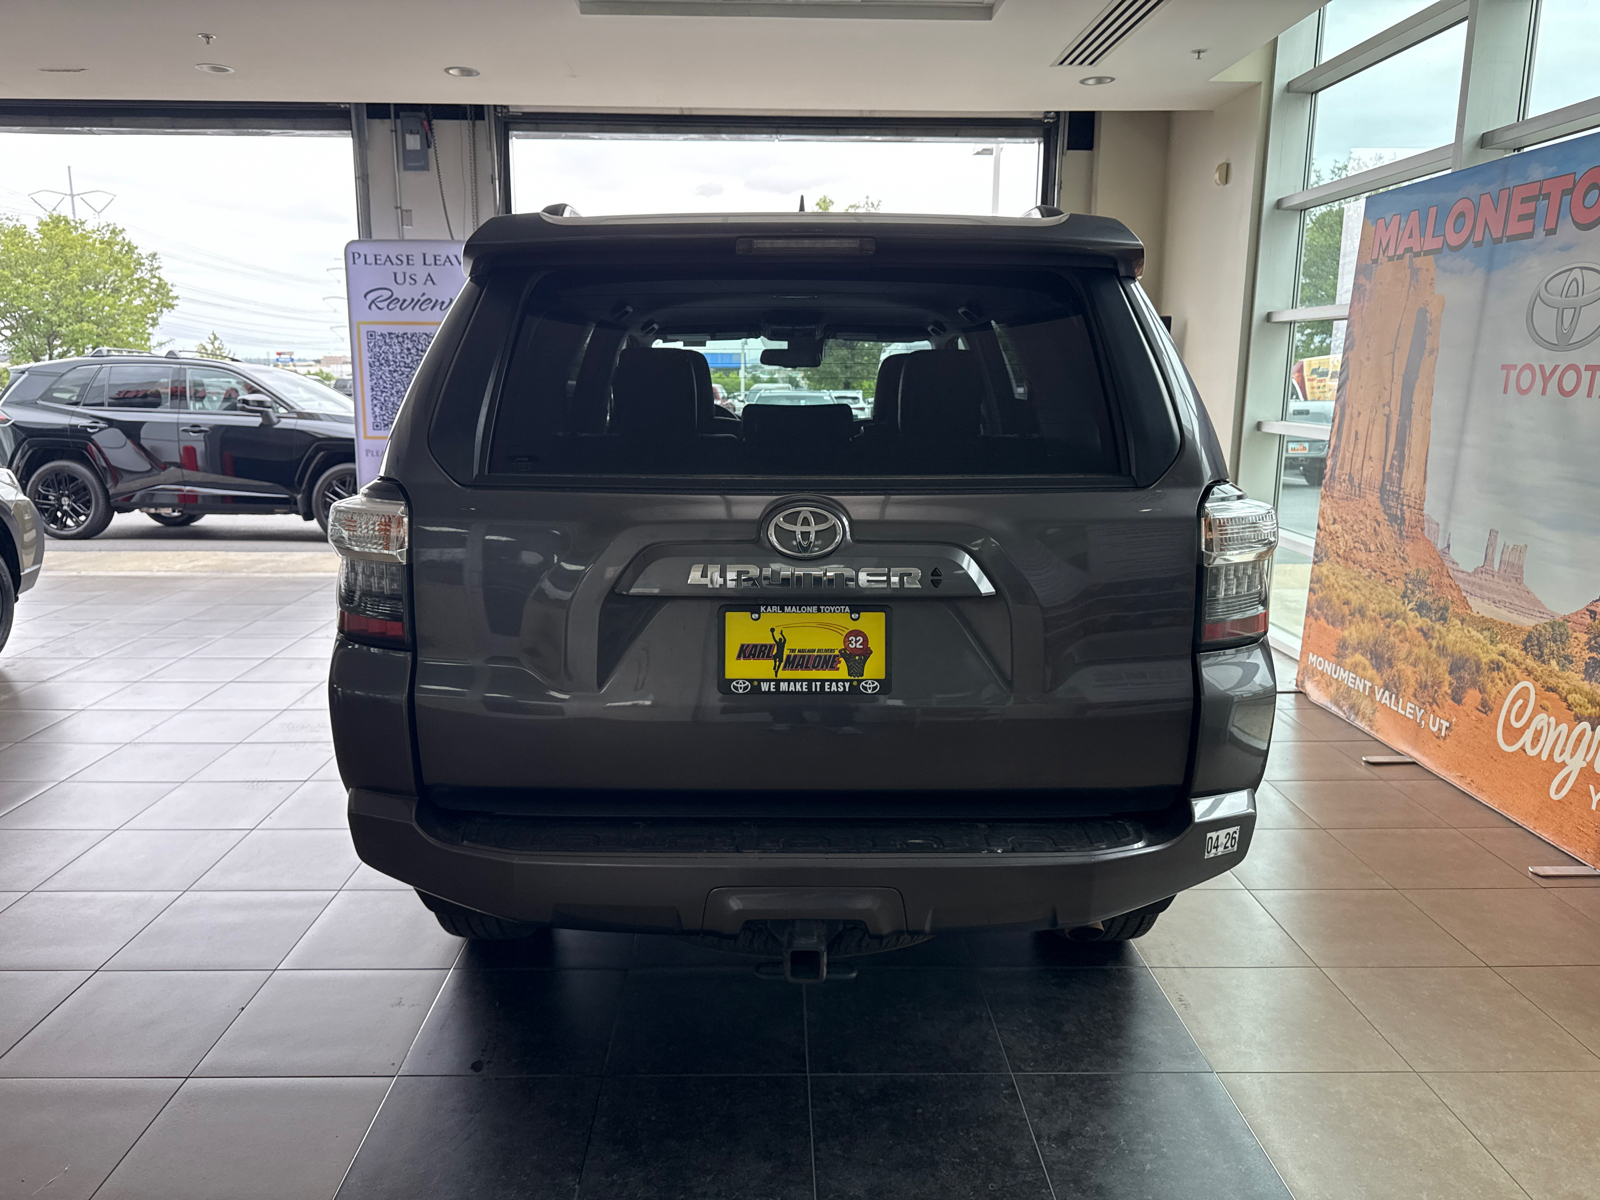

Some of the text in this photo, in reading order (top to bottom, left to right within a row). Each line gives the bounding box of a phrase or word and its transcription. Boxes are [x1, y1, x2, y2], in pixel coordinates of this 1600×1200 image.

[1371, 166, 1600, 264] MALONETO
[351, 251, 415, 266] PLEASE
[393, 271, 438, 286] US A
[363, 287, 453, 312] Review
[1501, 363, 1600, 398] TOYOT
[760, 605, 851, 613] KARL MALONE TOYOTA
[848, 636, 864, 649] 32
[735, 643, 776, 661] KARL
[782, 653, 841, 671] MALONE
[761, 682, 850, 691] WE MAKE IT EASY
[1308, 652, 1450, 737] MONUMENT VALLEY, UT
[1206, 830, 1238, 854] 04 26
